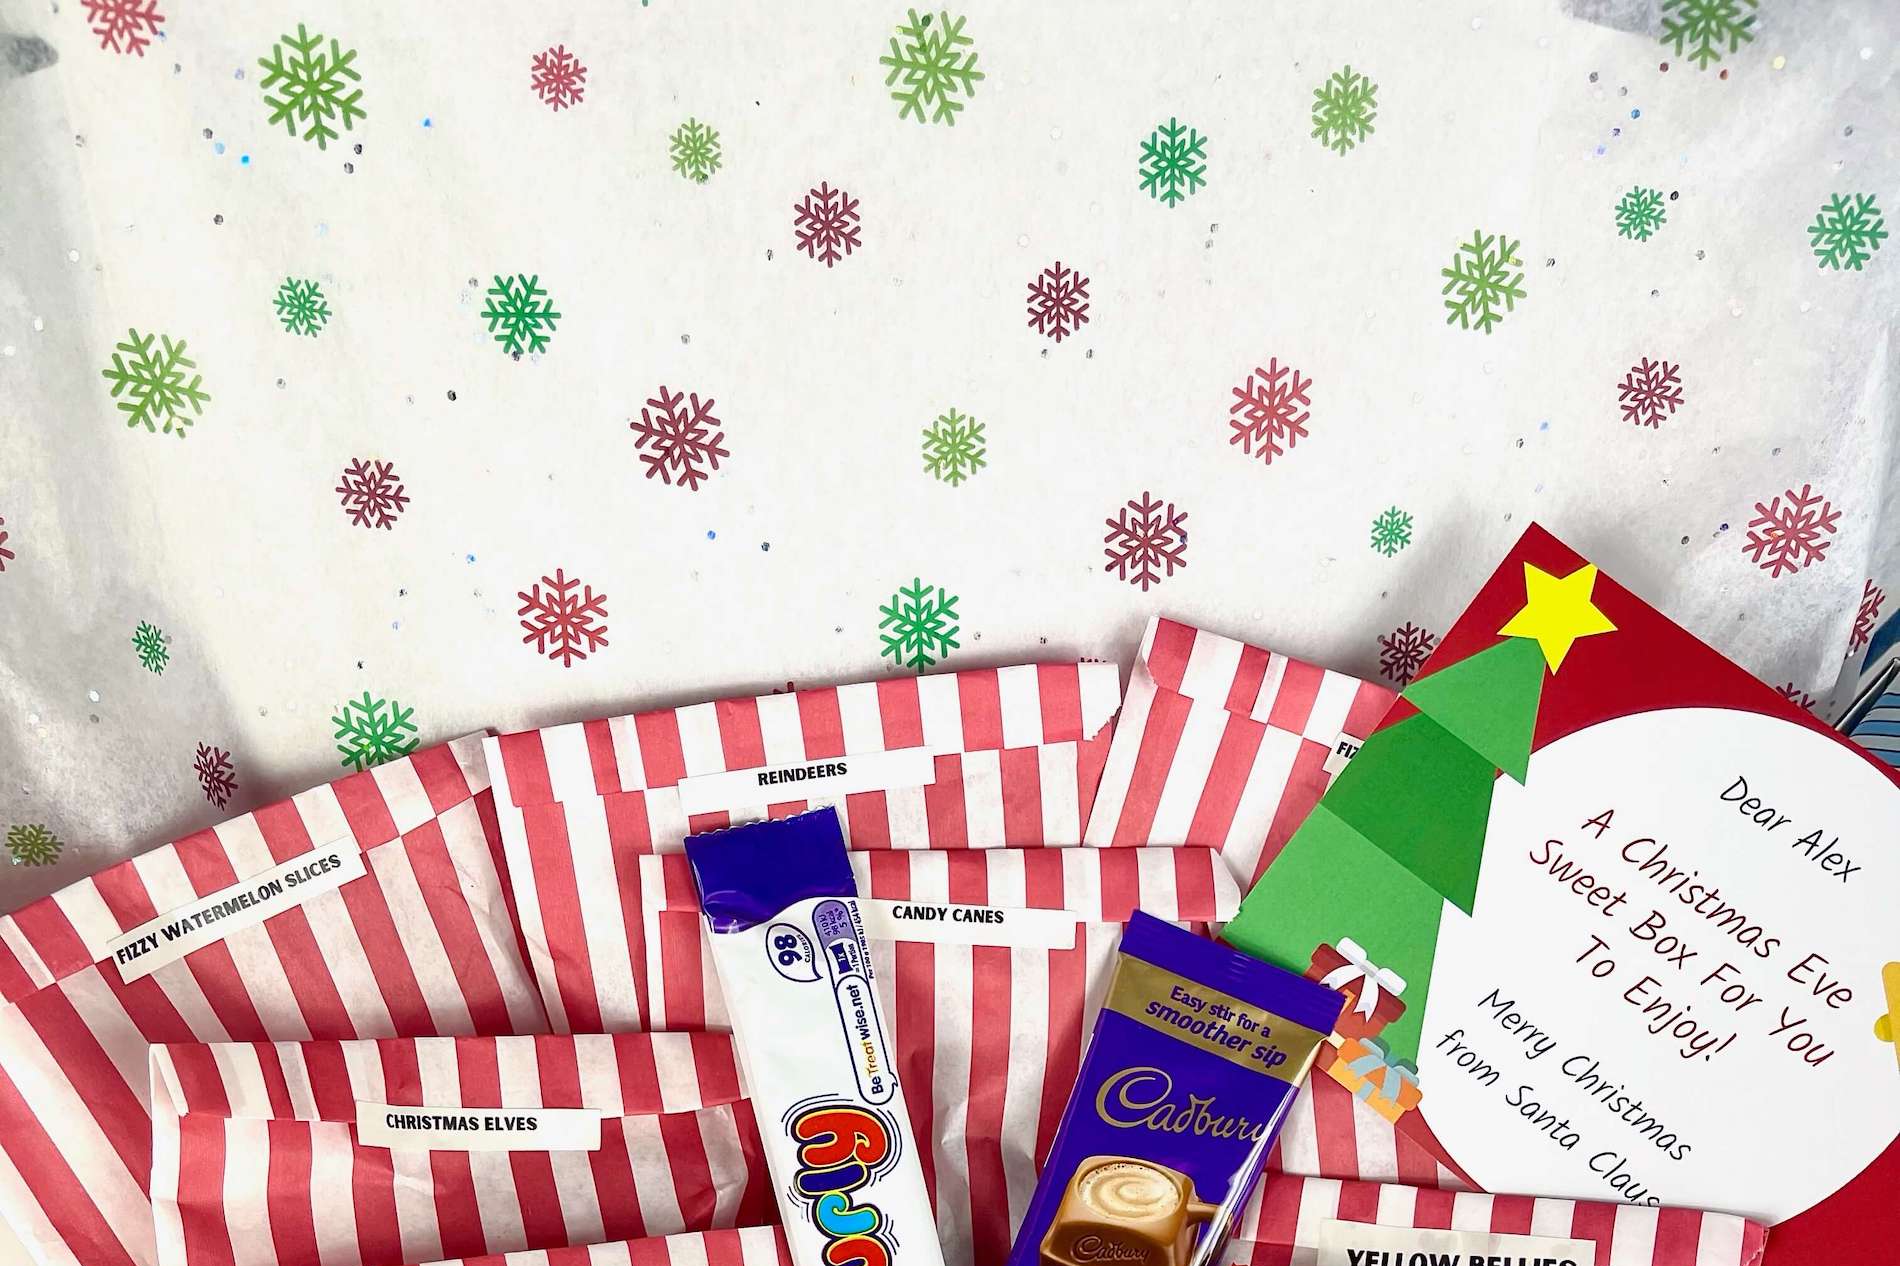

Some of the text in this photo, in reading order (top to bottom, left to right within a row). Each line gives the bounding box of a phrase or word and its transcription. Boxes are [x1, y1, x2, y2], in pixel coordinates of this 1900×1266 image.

[758, 763, 847, 786] REINDEERS
[1720, 776, 1861, 883] Dear Alex
[116, 854, 341, 965] FIZZY WATERMELON SLICES
[774, 934, 802, 966] 98
[893, 905, 1004, 923] CANDY CANES
[1530, 839, 1834, 1067] Sweet Box For You
[1581, 809, 1853, 1009] A Christmas Eve
[1145, 1001, 1287, 1069] smoother sip
[1170, 985, 1271, 1038] Easy stir for a
[1576, 935, 1737, 1061] To Enjoy!
[386, 1114, 538, 1131] CHRISTMAS ELVES
[1436, 1029, 1660, 1207] from Santa Claus
[1477, 988, 1691, 1160] Merry Christmas
